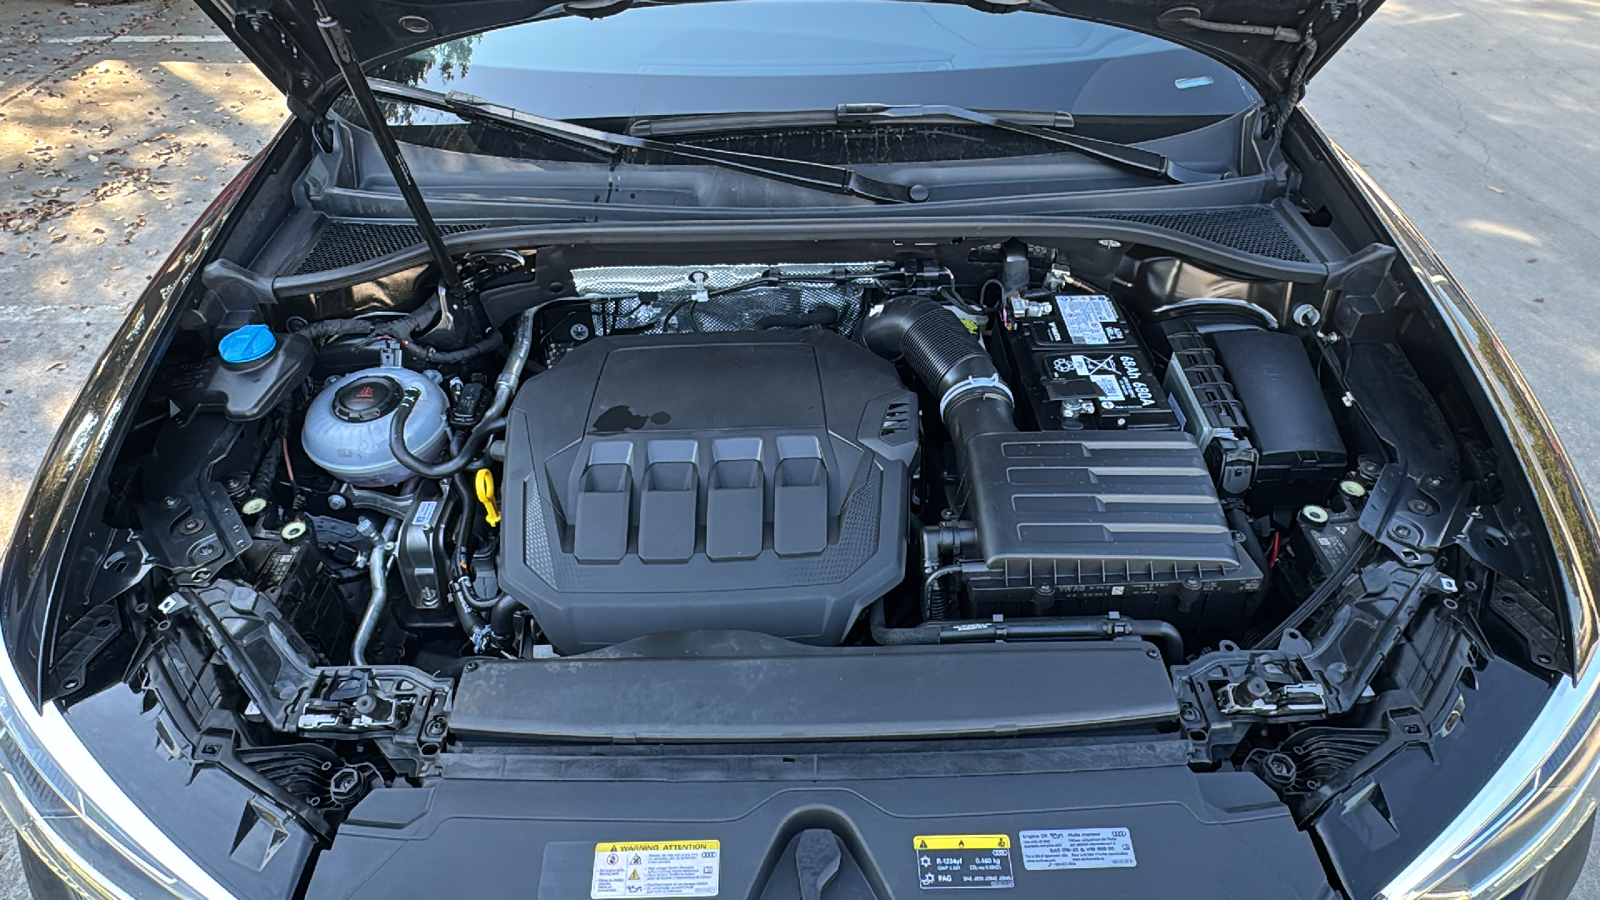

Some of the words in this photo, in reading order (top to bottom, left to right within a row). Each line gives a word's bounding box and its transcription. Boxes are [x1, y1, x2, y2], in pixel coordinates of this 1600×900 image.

[1120, 356, 1142, 379] 68Ah
[1132, 382, 1155, 406] 680A
[620, 844, 659, 852] WARNING
[663, 843, 707, 851] ATTENTION
